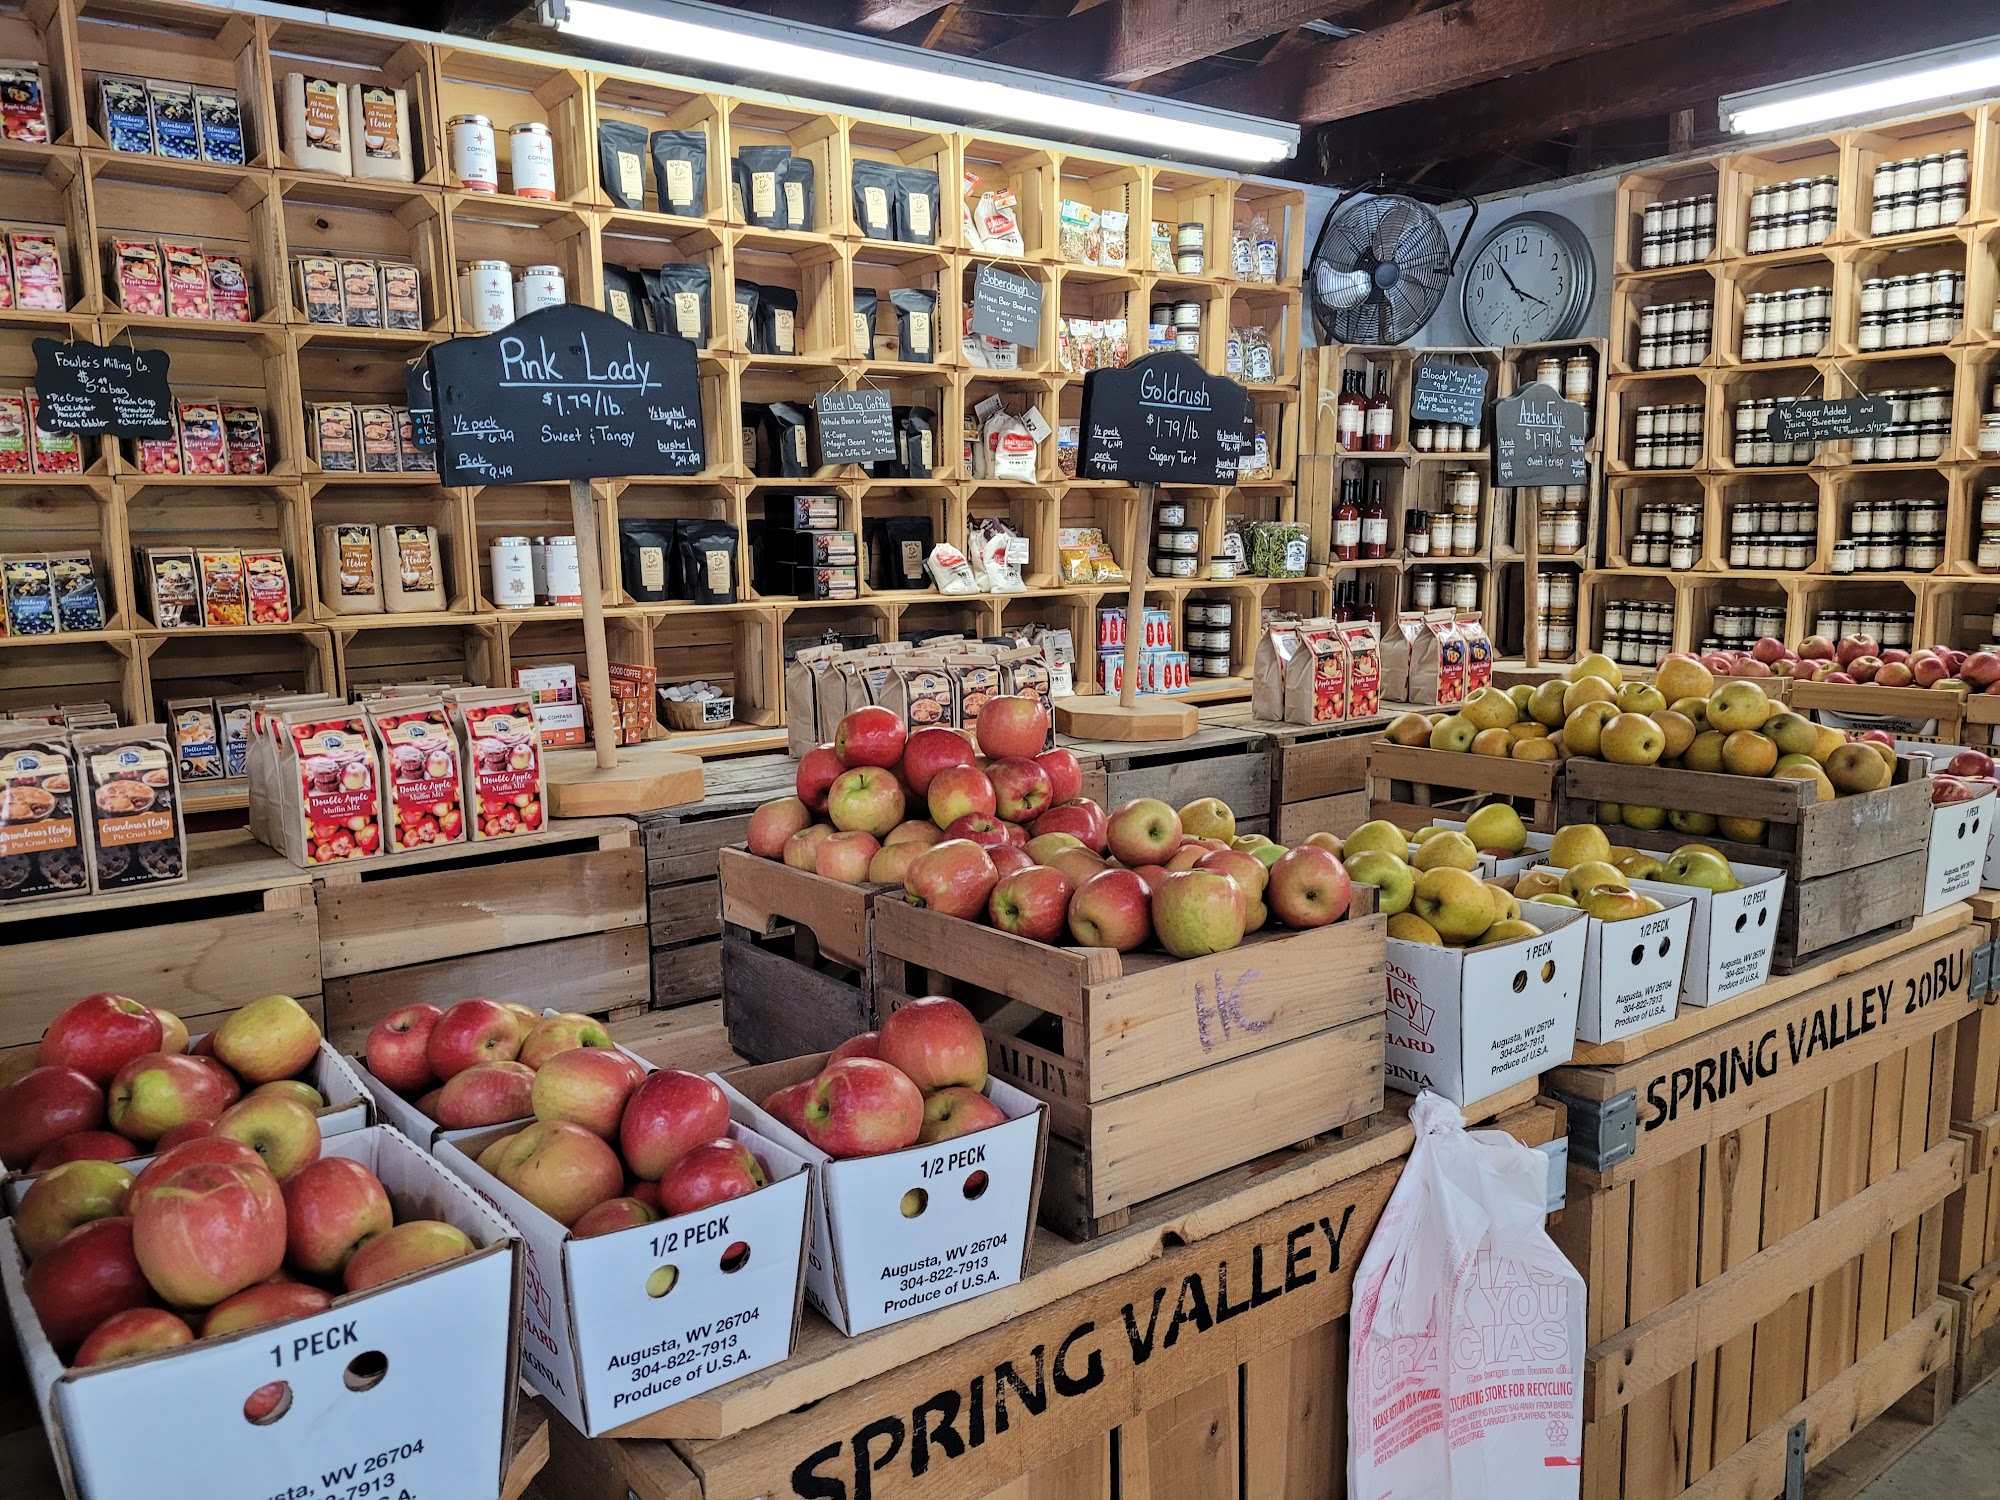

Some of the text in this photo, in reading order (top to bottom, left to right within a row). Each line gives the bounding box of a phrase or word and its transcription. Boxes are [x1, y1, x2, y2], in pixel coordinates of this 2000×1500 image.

[311, 108, 335, 121] Flour
[369, 117, 392, 129] Flour
[160, 122, 191, 133] Blueberry
[206, 126, 236, 137] Blueberry
[1498, 245, 1508, 262] 11
[1515, 235, 1528, 255] 12
[1538, 239, 1543, 257] 1
[1551, 253, 1558, 271] 2
[1481, 262, 1494, 281] 10
[1555, 276, 1563, 296] 3
[1477, 286, 1484, 306] 9
[1512, 326, 1520, 345] 6
[55, 352, 150, 377] Fowler's Milling Co.
[499, 332, 650, 396] Pink Lady
[1421, 367, 1467, 386] Bloody Mary
[109, 383, 129, 398] bag
[1139, 367, 1210, 407] Goldrush
[66, 393, 91, 403] Crust
[542, 390, 624, 416] $1.79/lb.
[822, 394, 890, 416] Black Dog Coffee
[1419, 391, 1457, 405] Apple Sauce
[1417, 402, 1449, 414] Hot Sauce
[1519, 400, 1564, 434] Aztec Fuji
[1780, 405, 1874, 421] No Sugar Added and
[57, 418, 109, 428] Peach Cobbler
[471, 418, 499, 433] peck
[666, 418, 697, 430] $16.49
[822, 414, 881, 426] Whole Bean Ground
[1146, 413, 1200, 443] $1.79/lb.
[1785, 415, 1851, 429] Juice Sweetened
[477, 431, 515, 444] $6.49
[541, 425, 635, 447] Sweet Tangy
[1102, 428, 1120, 437] peck
[1525, 428, 1564, 454] $1.79/lb.
[1794, 428, 1829, 440] pint jars
[657, 440, 692, 451] bushel
[1102, 439, 1123, 449] $6.49
[458, 453, 487, 466] Peck
[1094, 452, 1111, 461] peck
[1148, 446, 1198, 467] Sugary Tart
[1216, 457, 1238, 467] bushel
[479, 465, 513, 478] $9.49
[610, 665, 641, 679] GOOD COFFEE
[547, 713, 573, 721] COMPASS
[482, 771, 533, 784] Double Apple
[399, 780, 451, 794] Double Apple
[409, 790, 445, 802] Muffin Mix
[491, 781, 526, 793] Muffin Mix
[312, 793, 369, 808] Double Apple
[322, 804, 361, 815] Muffin Mix
[47, 824, 72, 840] Flaky
[102, 816, 170, 834] Grandma's Flaky
[113, 827, 162, 841] Pie Crust Mix
[11, 836, 64, 850] Pie Crust Mix
[1743, 888, 1767, 907] 1/2 PECK
[1640, 918, 1670, 938] 1/2 PECK
[1532, 940, 1553, 960] PECK
[1720, 948, 1766, 970] Augusta, WV 26704
[1725, 962, 1758, 980] 304-822-7913
[1616, 980, 1673, 1005] Augusta, WV 26704
[1718, 979, 1739, 992] Produce
[1623, 994, 1663, 1014] 304-822-7913
[1614, 1012, 1641, 1028] Produce
[1648, 1004, 1666, 1018] U.S.A.
[1491, 1018, 1555, 1051] Augusta, WV 26704
[1644, 948, 1964, 1132] SPRING VALLEY 20BU
[1500, 1034, 1545, 1060] 304-822-7913
[1491, 1045, 1549, 1076] Produce of U.S.A.
[920, 1144, 986, 1179] 1/2 PECK
[650, 1215, 730, 1257] 1/2 PECK
[880, 1233, 1008, 1281] Augusta, WV 26704
[899, 1256, 989, 1292] 304-822-7913
[884, 1272, 1001, 1315] Produce of U.S.A.
[1480, 1284, 1569, 1327] YOU
[270, 1320, 360, 1368] 1 PECK
[607, 1307, 760, 1372] Augusta, WV 26704
[631, 1334, 738, 1382] 304-822-7913
[791, 1204, 1355, 1500] SPRING VALLEY
[613, 1351, 751, 1409] Produce of U.S.A.
[1485, 1366, 1554, 1381] tenga un buen
[1485, 1381, 1573, 1401] STORE FOR RECYCLING
[1553, 1400, 1573, 1410] BABIES
[321, 1439, 425, 1489] WV 26704
